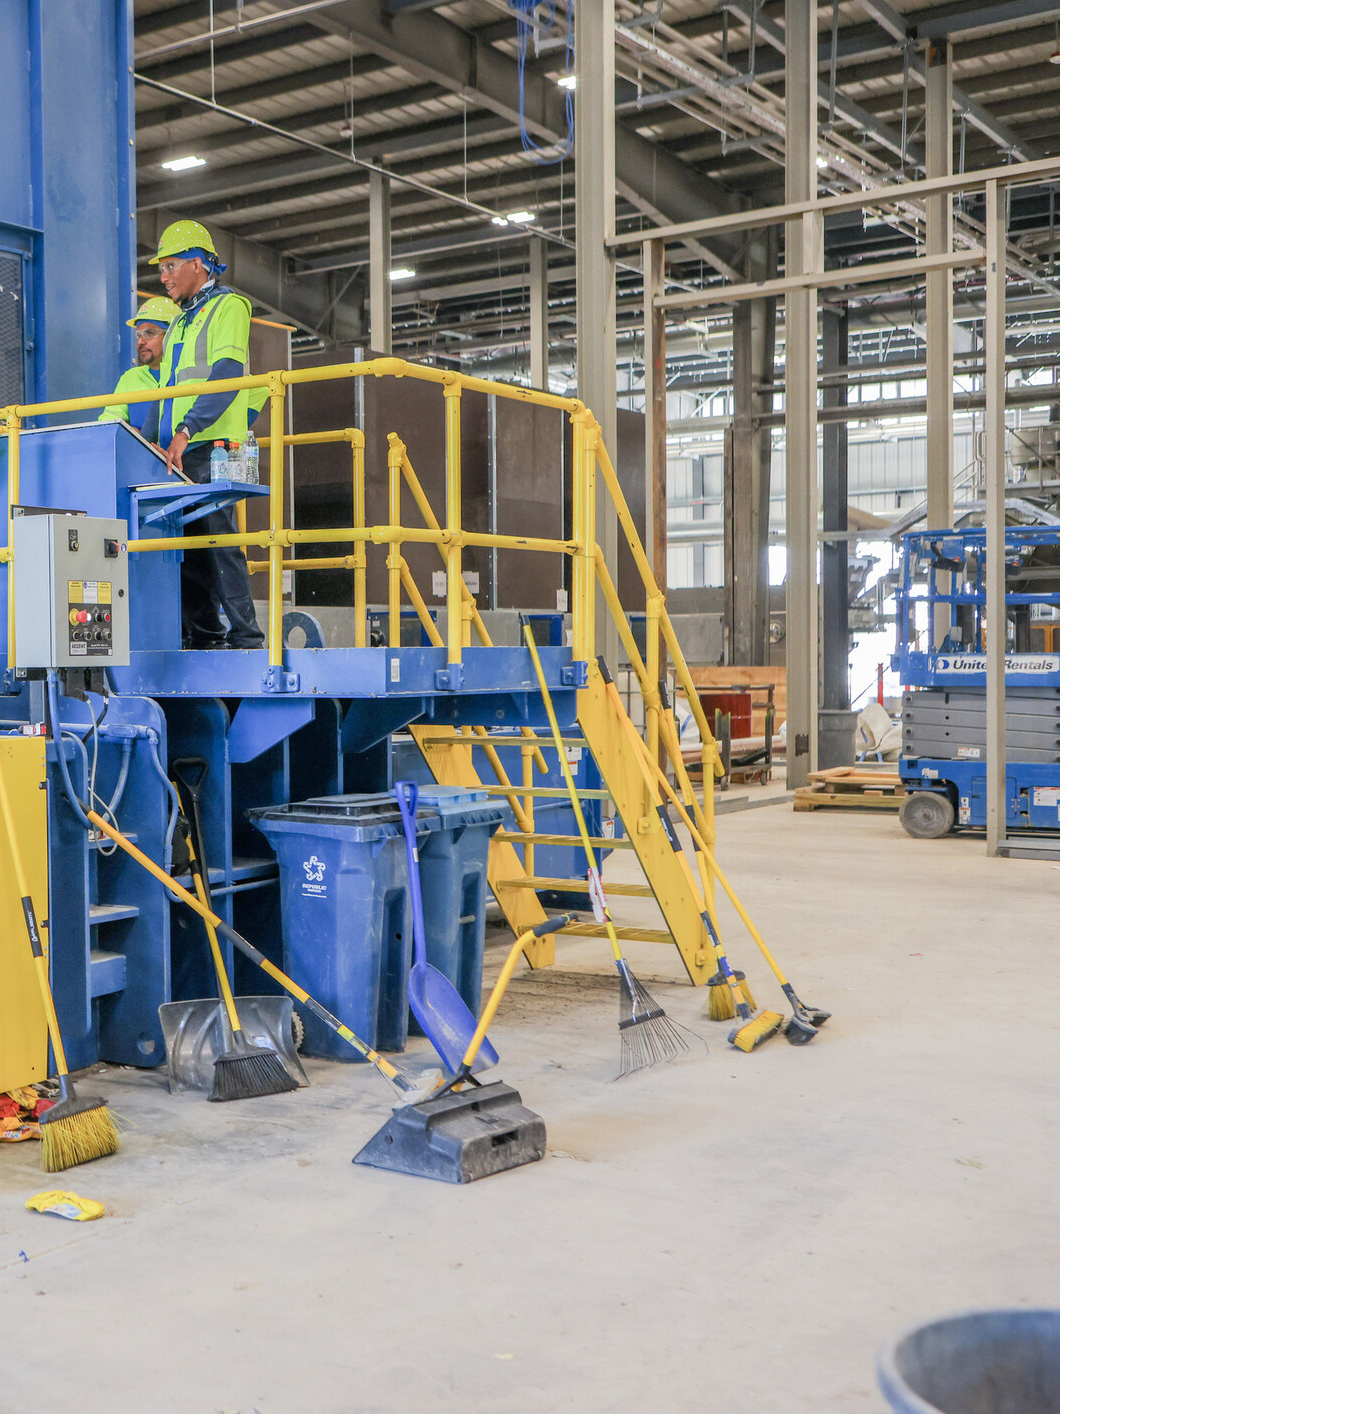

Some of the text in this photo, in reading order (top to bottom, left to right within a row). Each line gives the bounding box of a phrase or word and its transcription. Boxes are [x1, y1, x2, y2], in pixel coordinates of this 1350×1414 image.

[953, 660, 1052, 670] Unite Rentals
[302, 883, 327, 891] REPUBLIC
